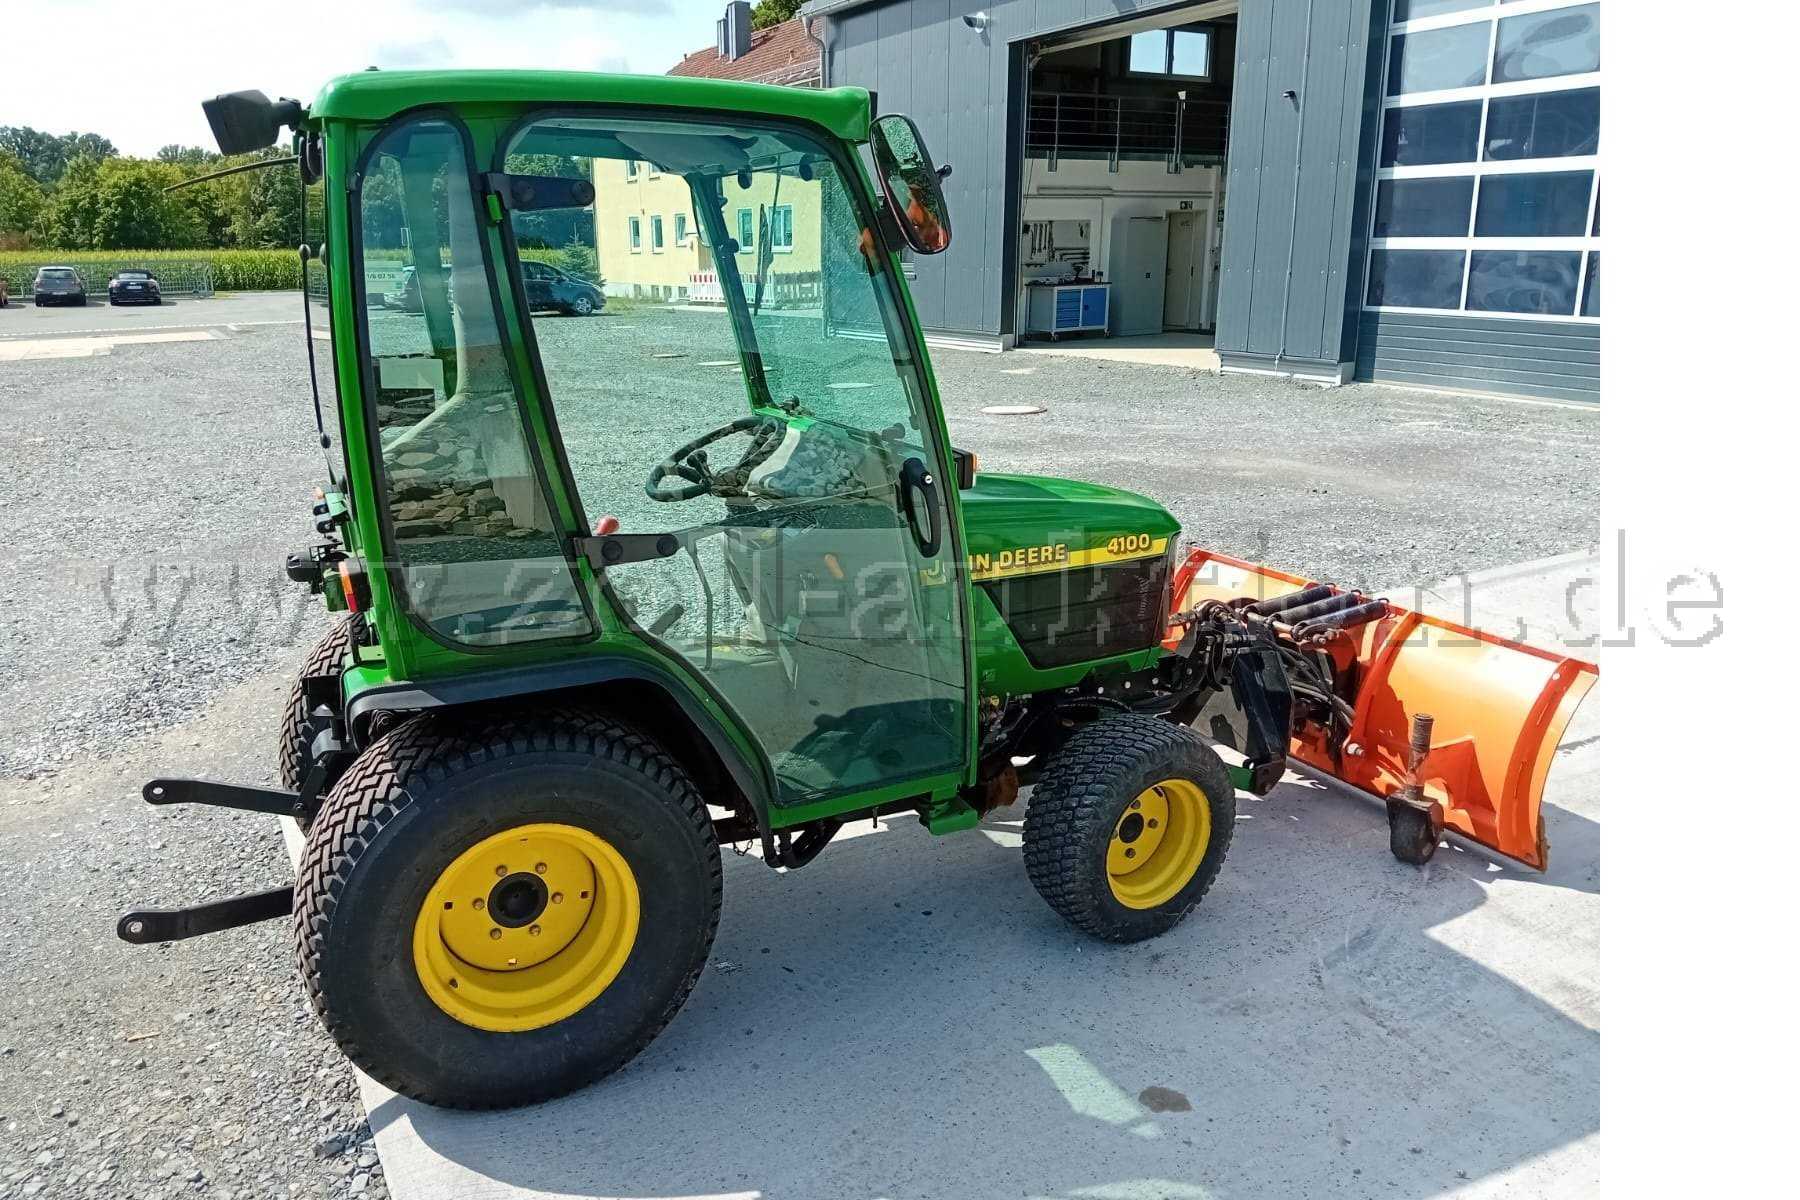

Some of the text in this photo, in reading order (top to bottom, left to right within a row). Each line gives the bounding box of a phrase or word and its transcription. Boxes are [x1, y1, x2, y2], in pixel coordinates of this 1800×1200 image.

[927, 533, 1151, 576] JN DEERE 4100
